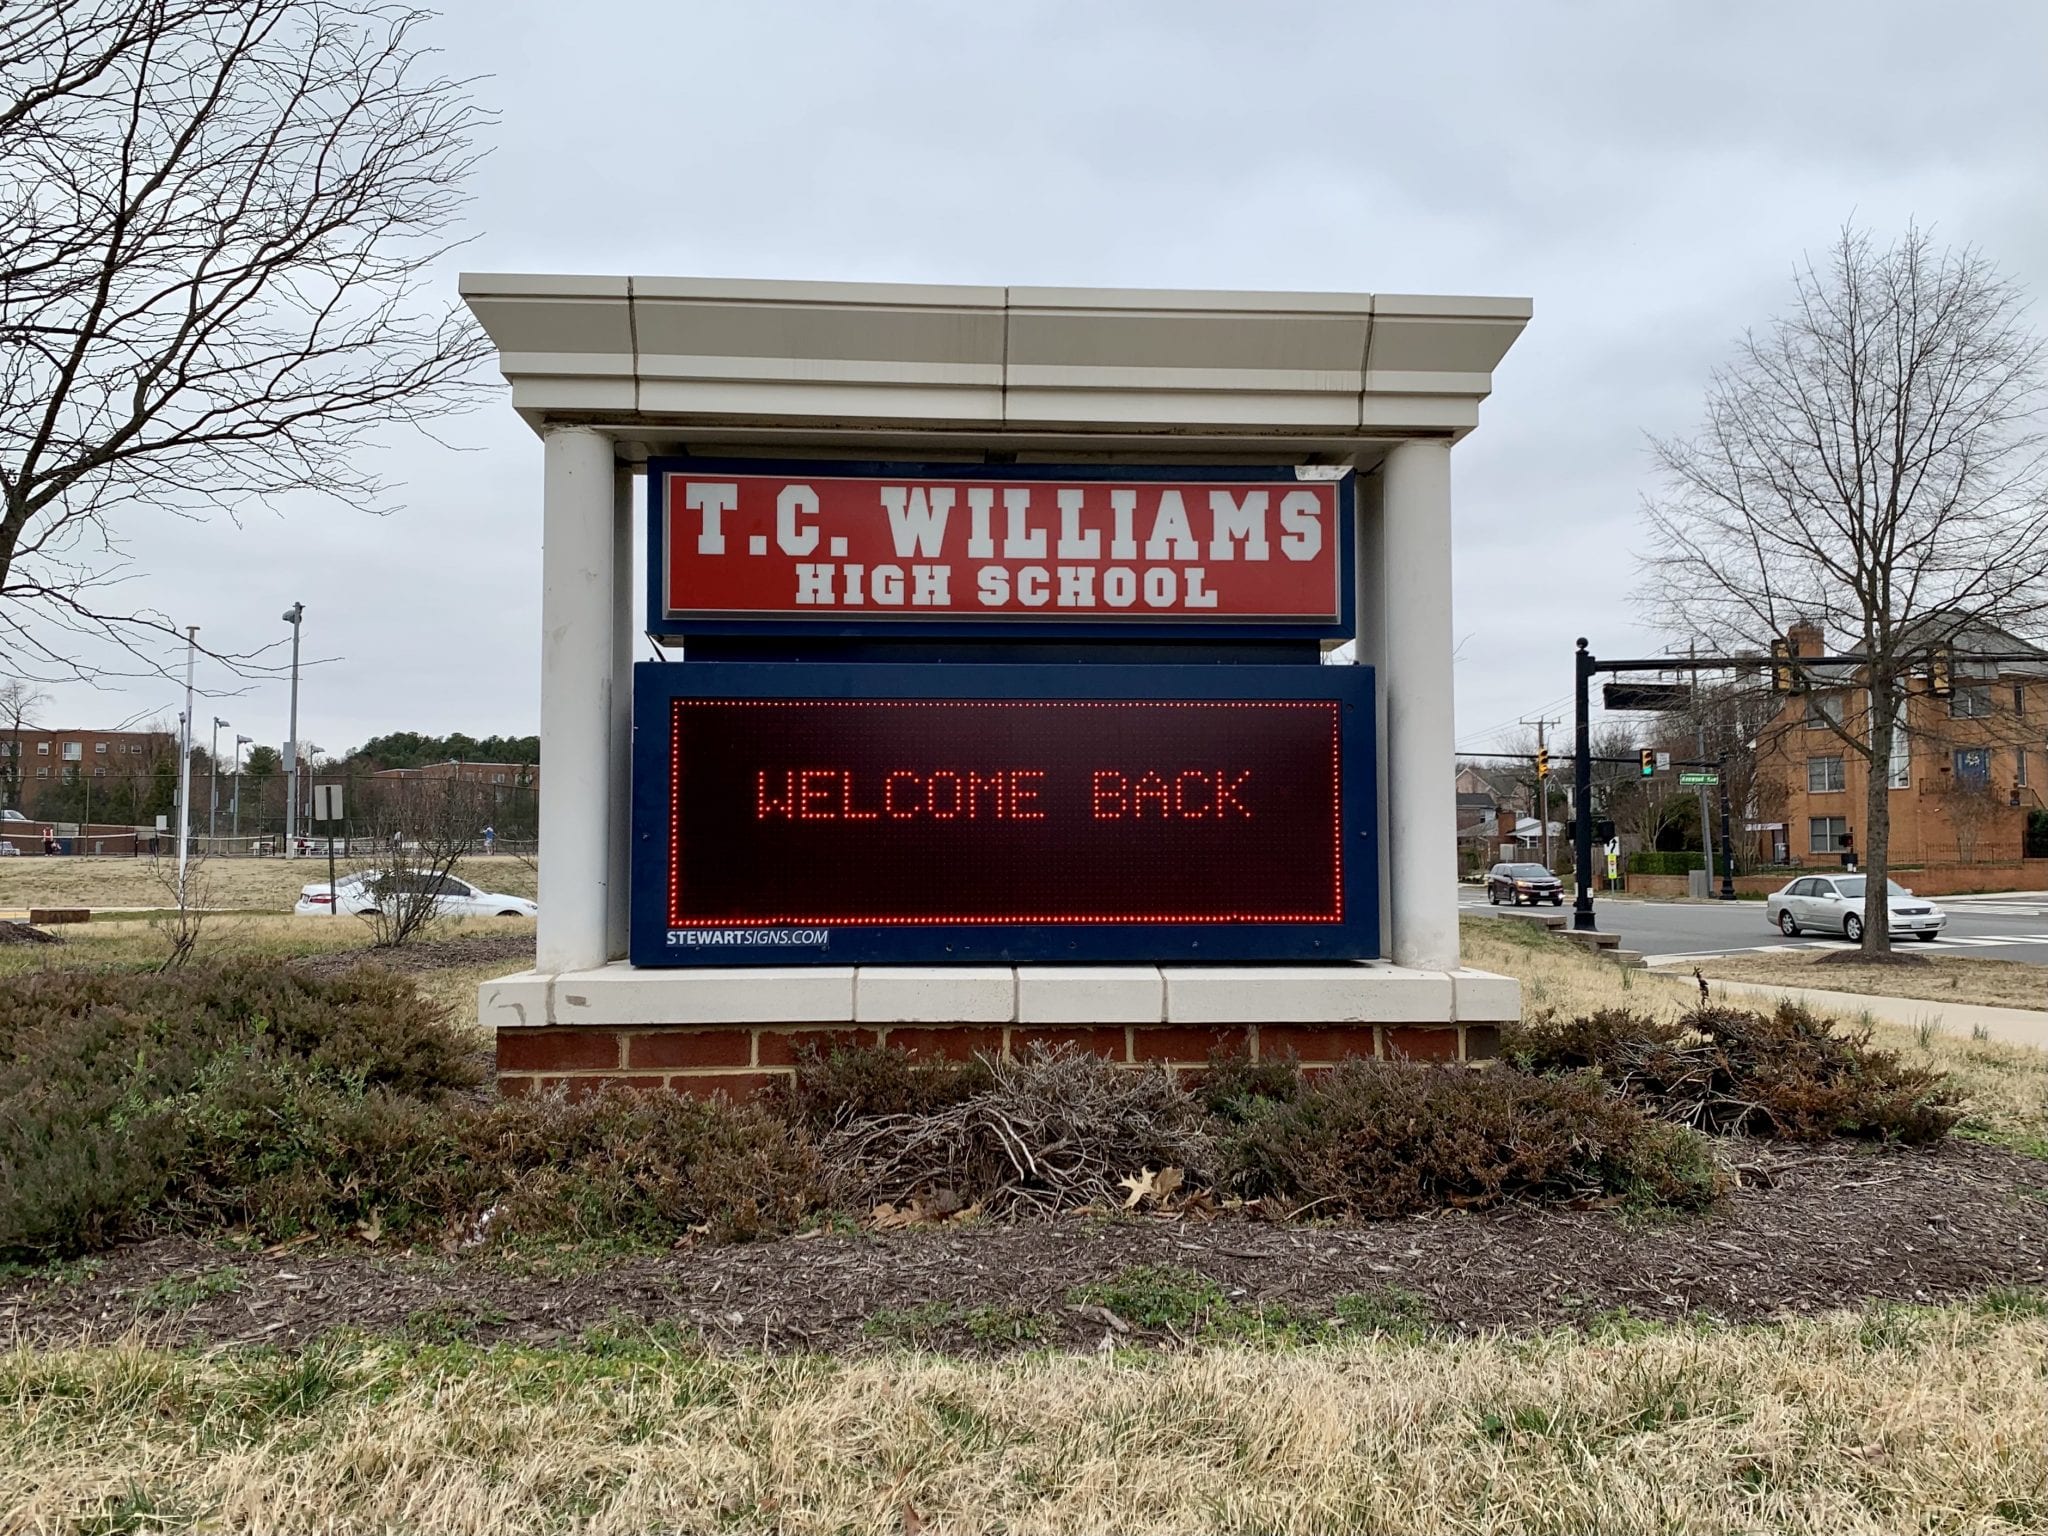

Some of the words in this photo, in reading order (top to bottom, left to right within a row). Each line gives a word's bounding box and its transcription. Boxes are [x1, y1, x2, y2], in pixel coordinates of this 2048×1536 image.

[880, 487, 1322, 562] WILLIAMS
[795, 563, 951, 605] HIGH
[978, 565, 1218, 607] SCHOOL
[758, 770, 1045, 819] WELCOME
[1093, 770, 1251, 819] BACK
[666, 930, 829, 945] STEWARTSIGNS.COM
